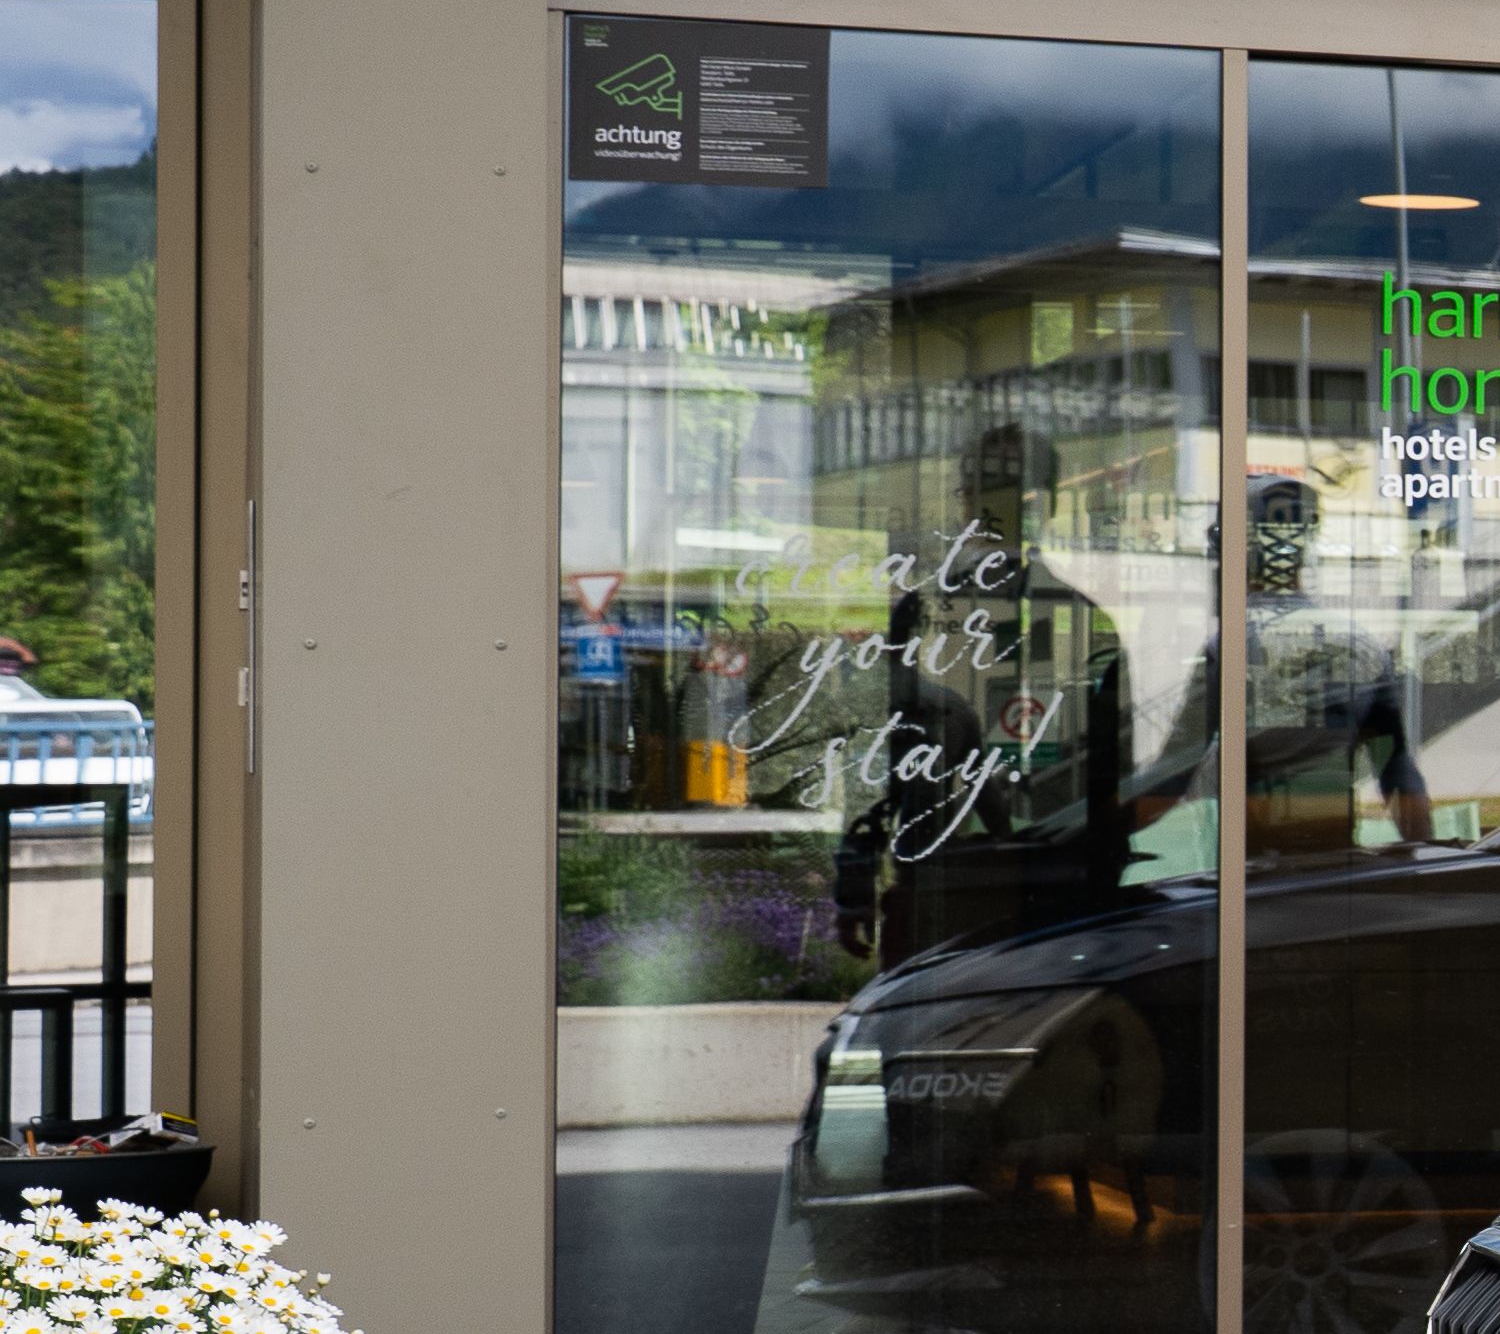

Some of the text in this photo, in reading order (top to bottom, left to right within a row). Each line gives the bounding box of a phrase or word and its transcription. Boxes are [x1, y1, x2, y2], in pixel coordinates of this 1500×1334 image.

[594, 124, 682, 150] achtung
[1382, 427, 1496, 462] hotels
[727, 609, 1028, 754] your
[792, 691, 1064, 862] stay!
